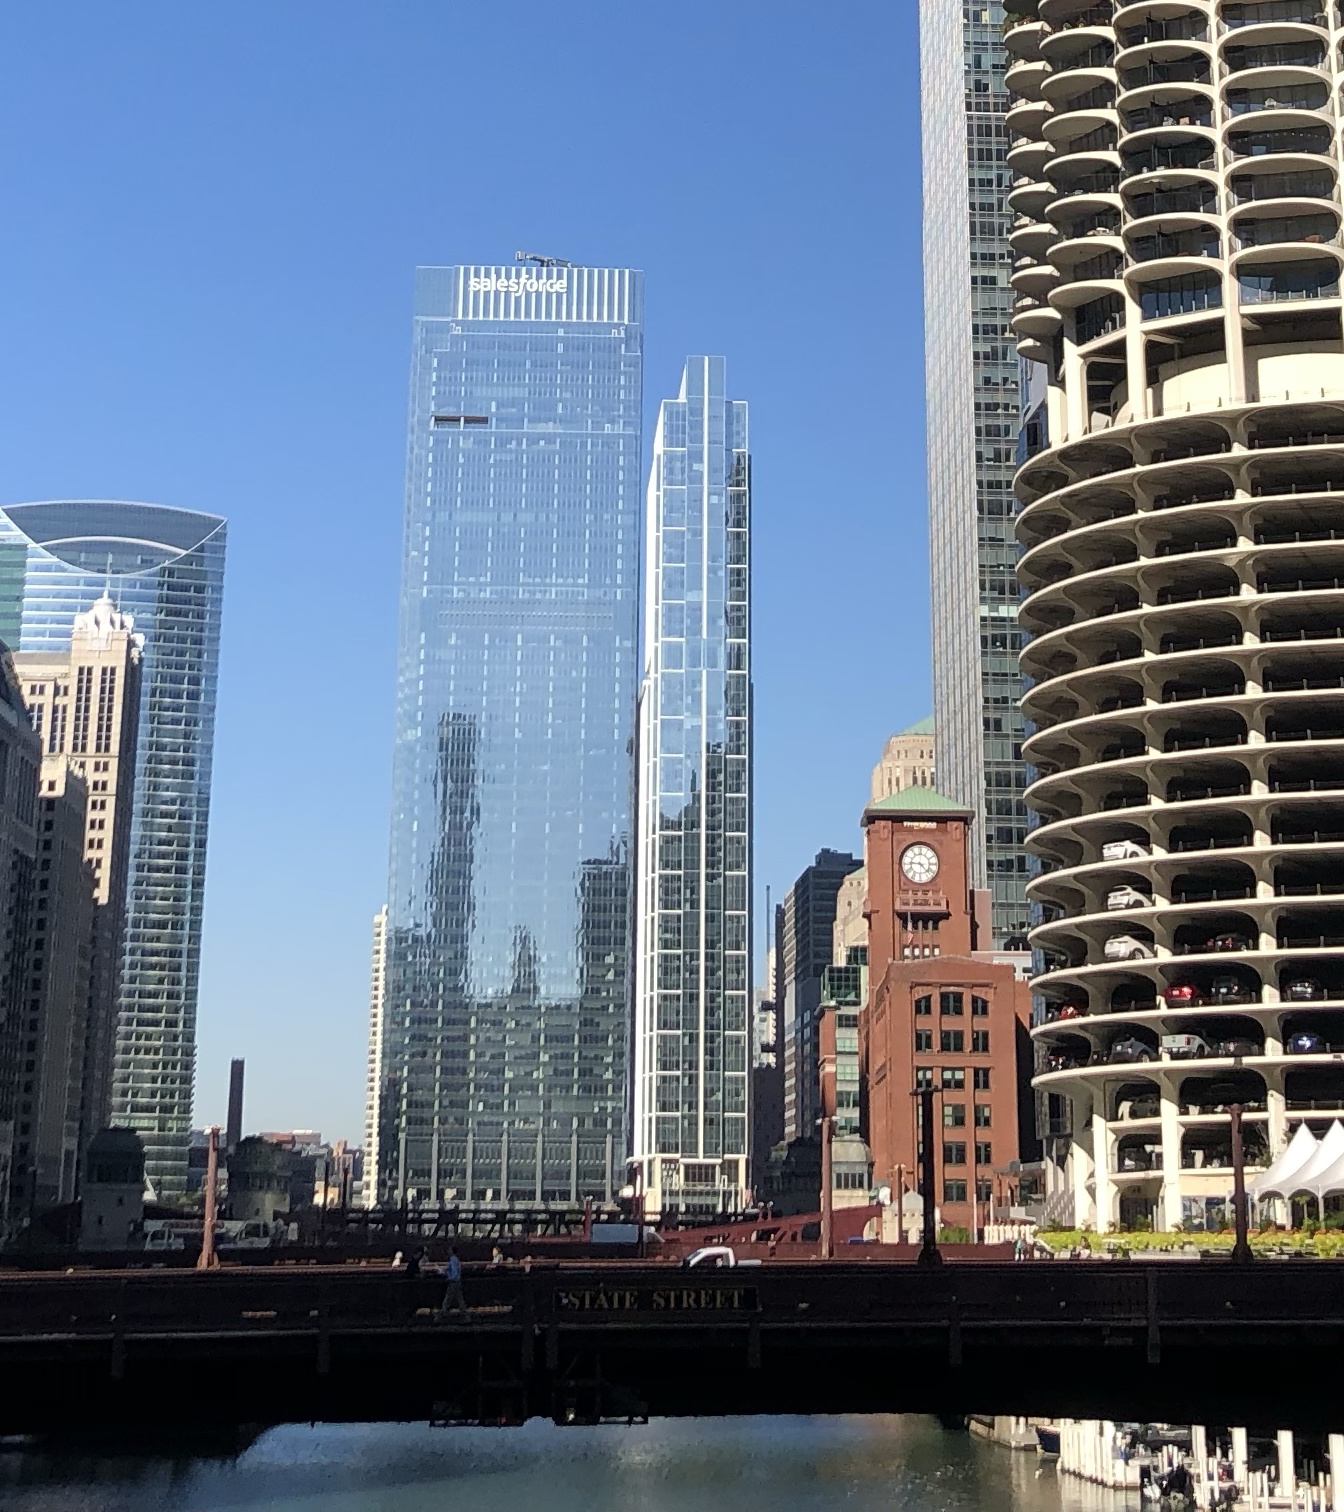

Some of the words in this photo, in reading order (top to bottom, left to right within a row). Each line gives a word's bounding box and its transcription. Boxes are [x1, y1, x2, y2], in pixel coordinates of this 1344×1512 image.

[469, 274, 567, 296] salesforce
[568, 1289, 638, 1309] STATE
[652, 1289, 744, 1309] STREET
